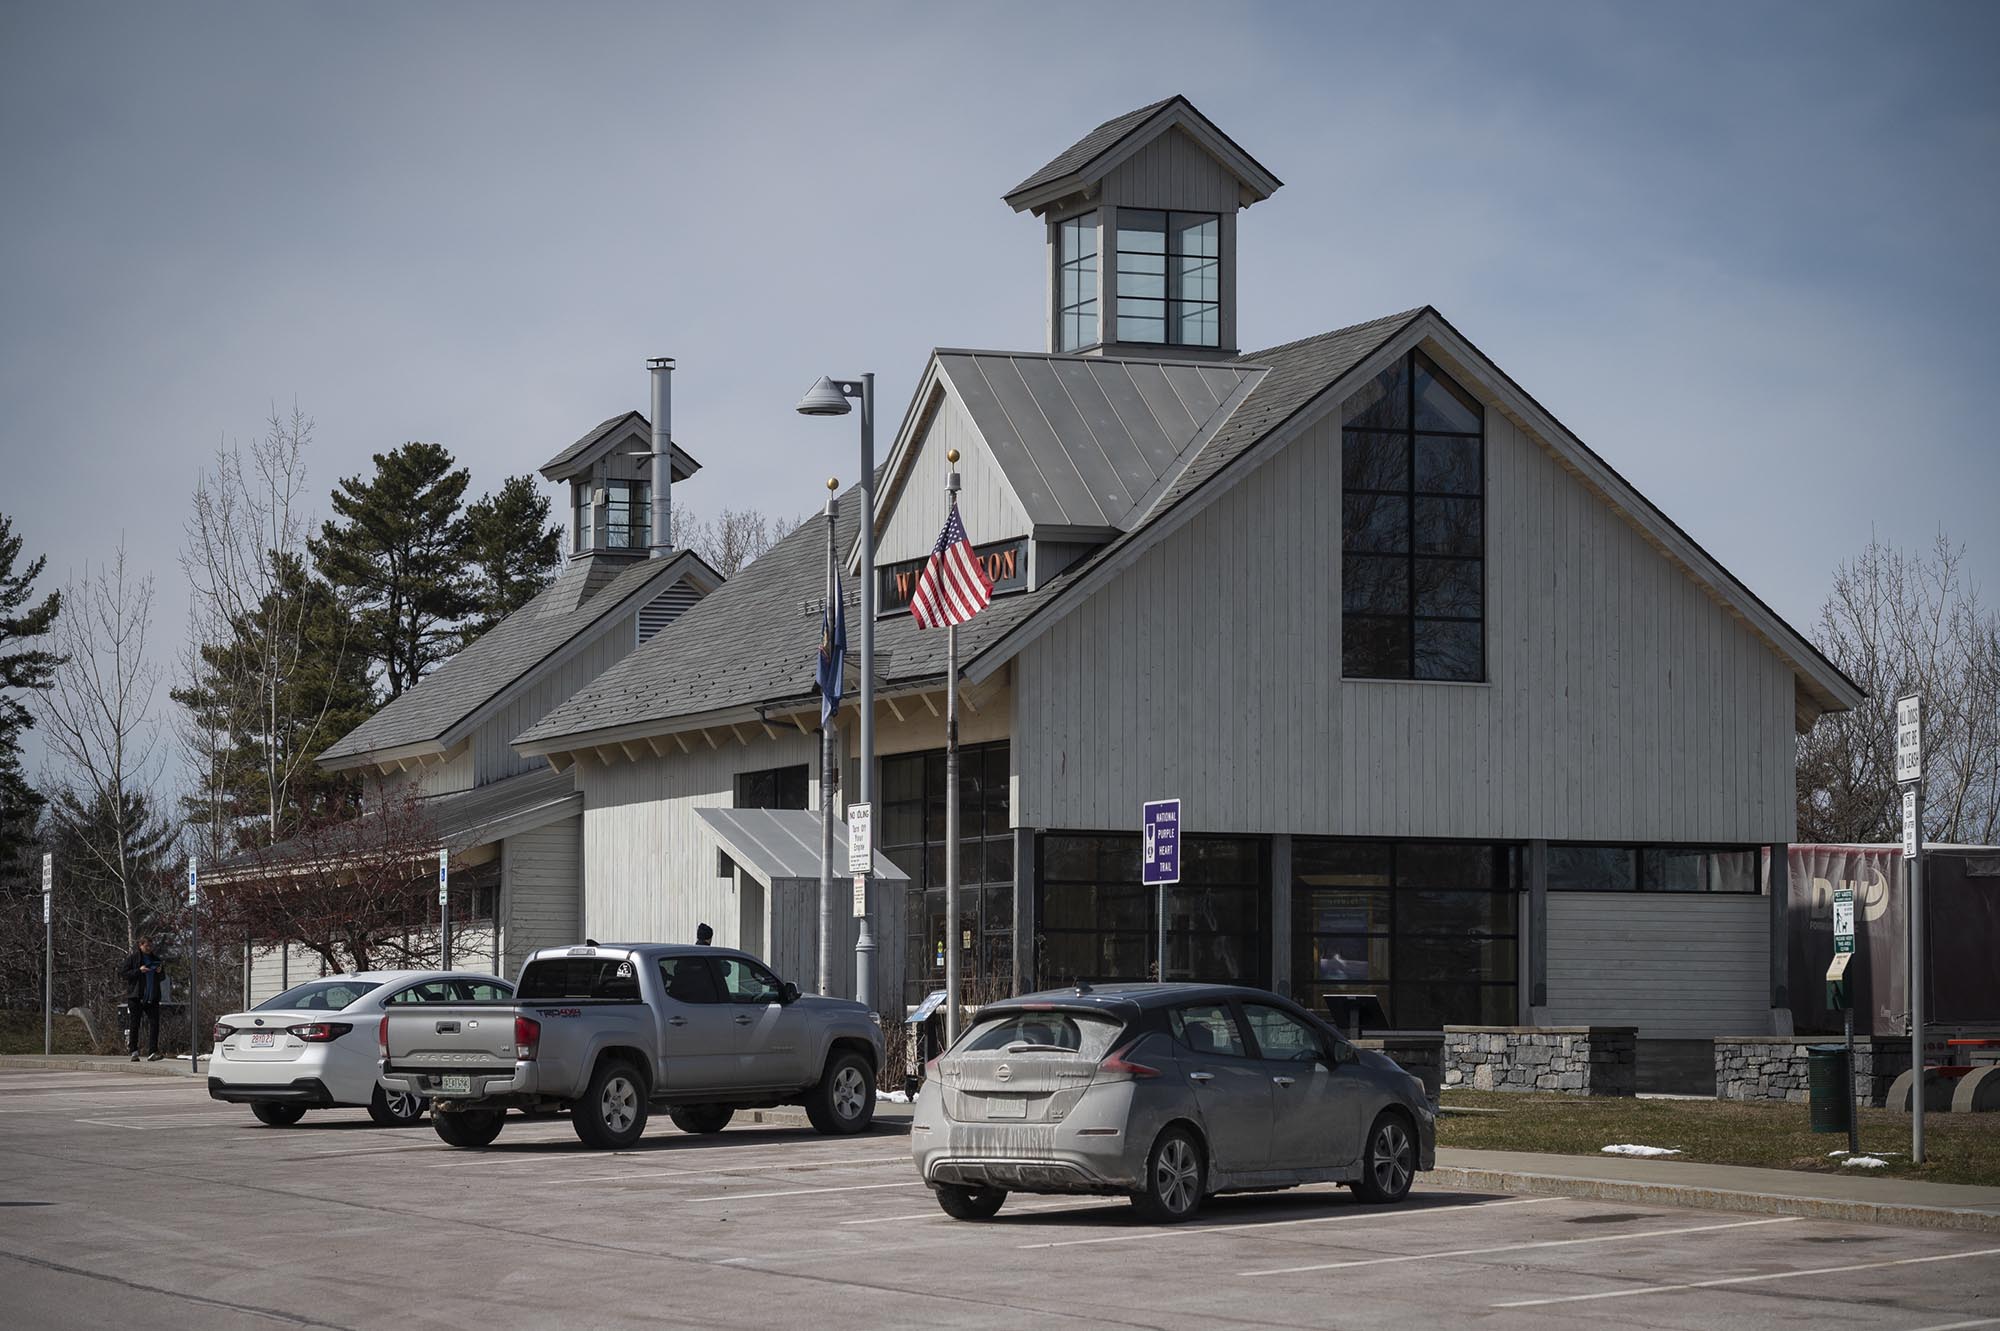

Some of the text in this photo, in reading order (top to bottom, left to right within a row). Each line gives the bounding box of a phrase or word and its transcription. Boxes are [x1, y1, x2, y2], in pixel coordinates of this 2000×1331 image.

[850, 810, 869, 819] NO IDLING
[1156, 812, 1177, 822] NATIONAL
[1158, 828, 1175, 839] PURPLE
[1159, 845, 1173, 856] HEART
[1160, 862, 1173, 872] TRAIL
